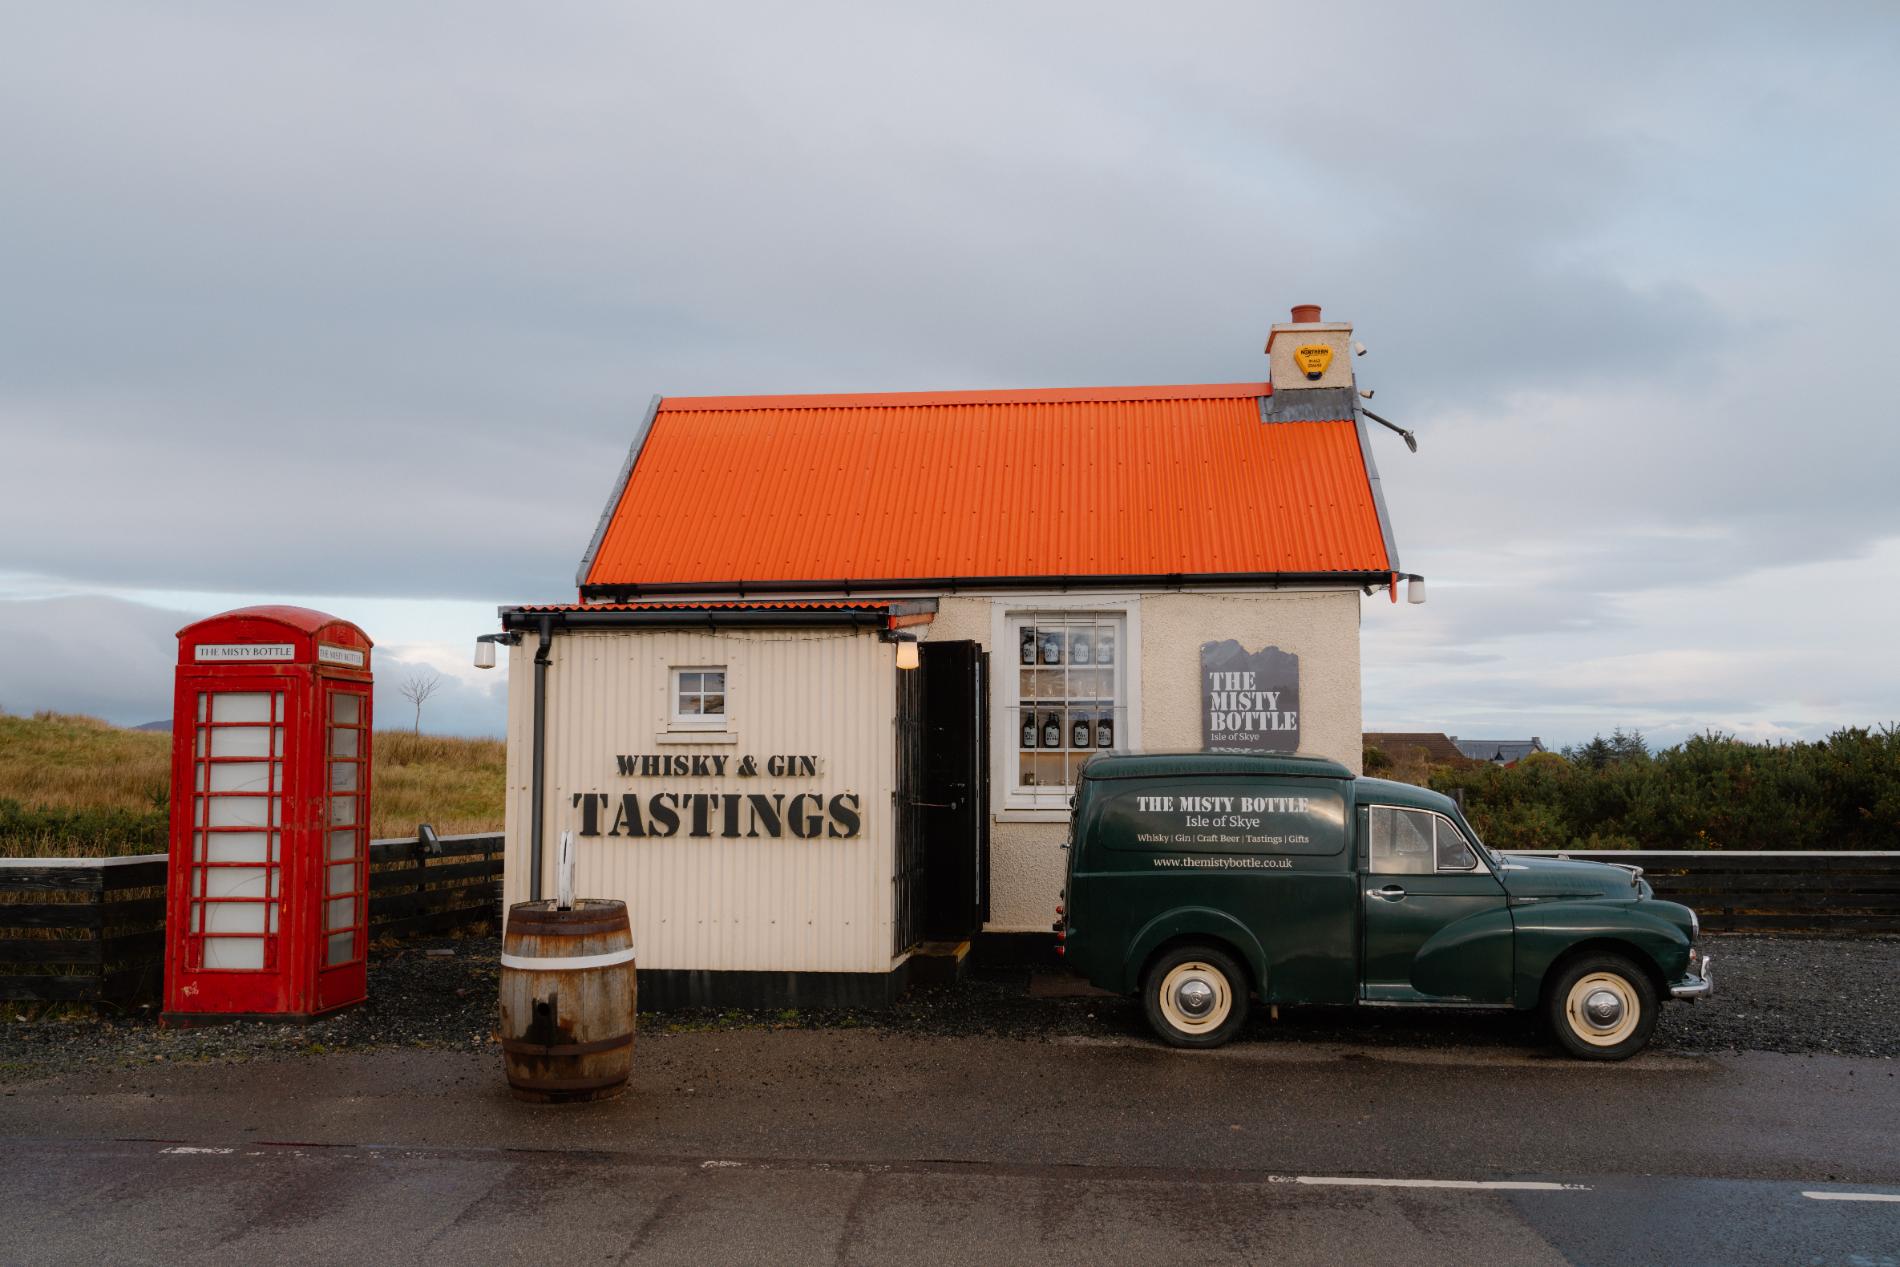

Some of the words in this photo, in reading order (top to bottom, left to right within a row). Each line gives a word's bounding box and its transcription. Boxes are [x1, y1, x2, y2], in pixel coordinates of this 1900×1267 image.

[201, 648, 219, 656] THE
[221, 648, 252, 656] MISTY
[253, 647, 292, 656] BOTTLE
[1209, 671, 1256, 691] THE
[1210, 691, 1280, 711] MISTY
[1210, 711, 1297, 731] BOTTLE
[1211, 733, 1227, 741] Isle
[1228, 732, 1238, 741] of
[1239, 732, 1260, 742] Skye
[616, 754, 729, 777] WHISKY
[735, 754, 758, 777] &
[767, 754, 818, 777] GIN
[1137, 796, 1174, 812] THE
[1179, 796, 1235, 813] MISTY
[1241, 797, 1309, 813] BOTTLE
[572, 792, 862, 839] TASTINGS
[1186, 815, 1210, 828] Isle
[1212, 815, 1227, 828] of
[1229, 815, 1261, 830] Skye
[1137, 833, 1169, 843] Whisky
[1175, 834, 1192, 842] Gin
[1197, 834, 1218, 842] Craft
[1220, 834, 1240, 842] Beer
[1246, 834, 1283, 845] Tastings
[1288, 834, 1310, 843] Gifts
[1153, 857, 1293, 869] www.themistybottle.co.uk
